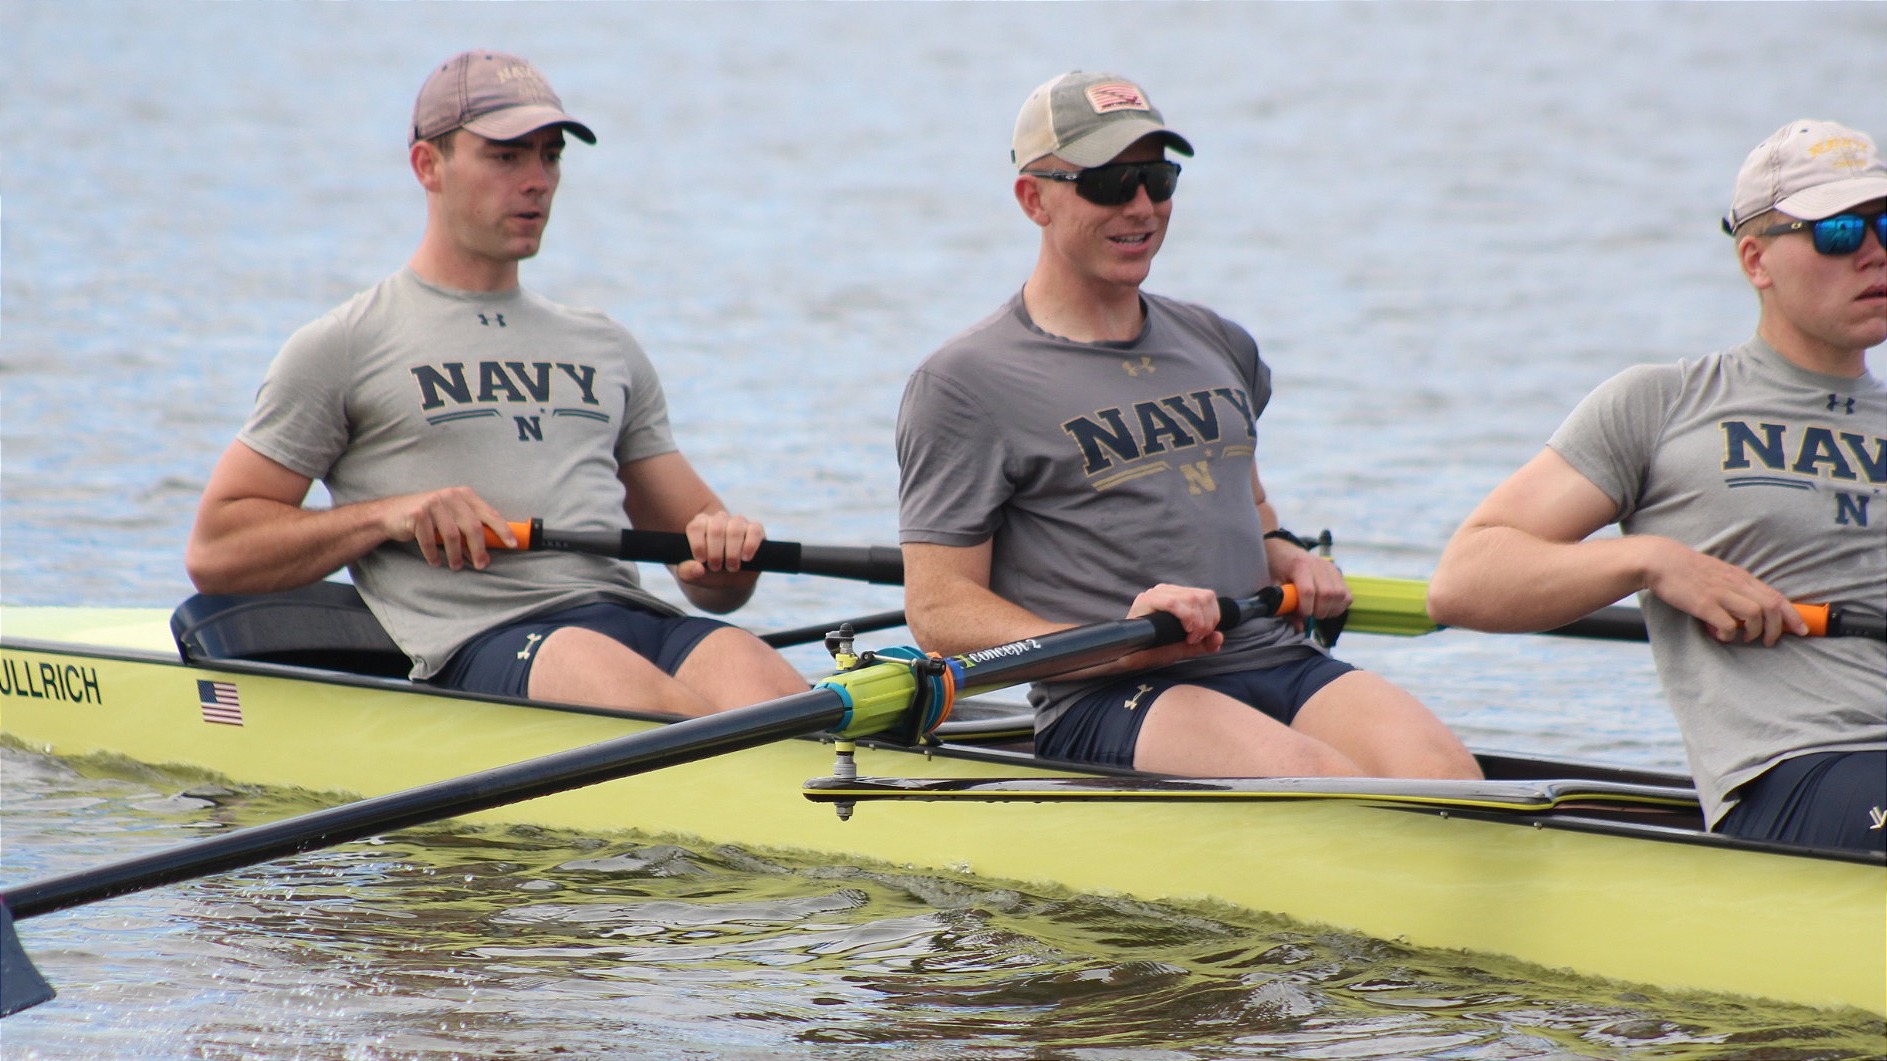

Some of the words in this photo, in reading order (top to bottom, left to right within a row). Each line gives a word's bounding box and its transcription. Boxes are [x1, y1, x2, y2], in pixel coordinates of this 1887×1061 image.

[410, 360, 600, 412] NAVY
[513, 416, 544, 442] N
[1061, 387, 1257, 478] NAVY
[1179, 460, 1217, 495] N
[1835, 492, 1871, 528] N
